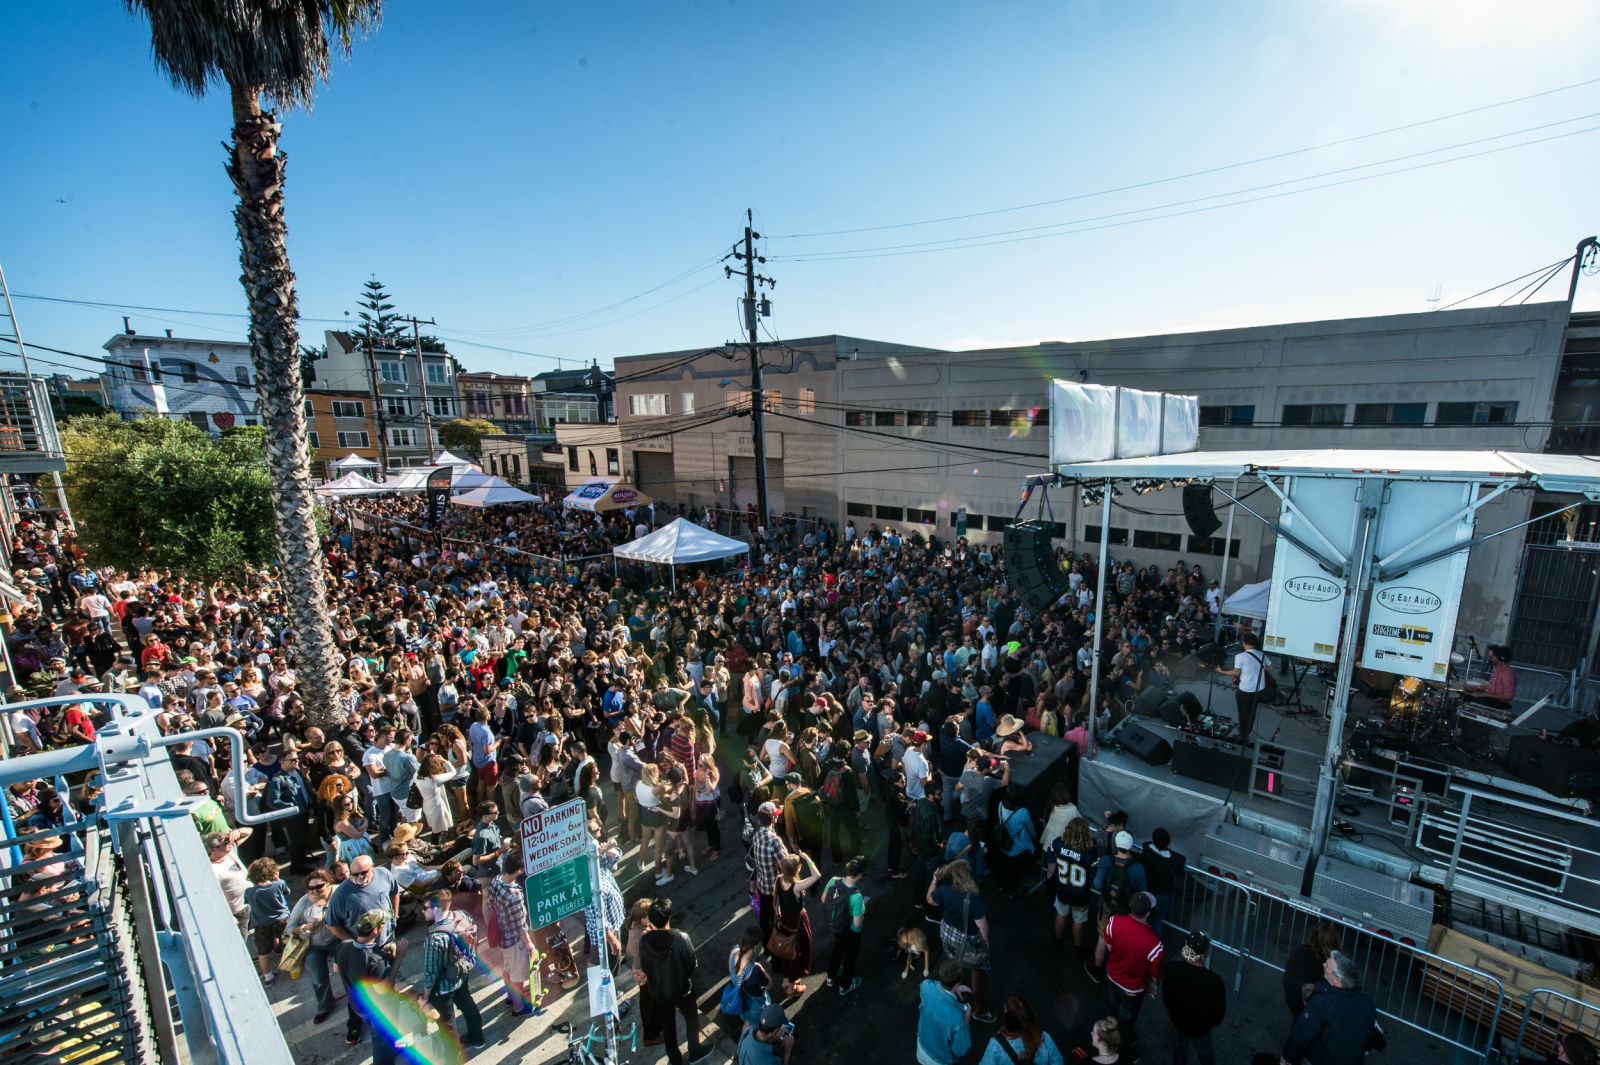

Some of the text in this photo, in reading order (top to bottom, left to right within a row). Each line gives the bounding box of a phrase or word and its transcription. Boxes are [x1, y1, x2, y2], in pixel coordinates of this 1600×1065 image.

[1289, 581, 1301, 590] Big
[1317, 585, 1338, 594] Audio
[1382, 592, 1395, 602] Big
[1397, 594, 1411, 602] Ear
[1414, 595, 1439, 606] Audio
[1374, 624, 1401, 638] STAGELINE
[523, 803, 581, 837] NO PARKING
[529, 832, 582, 862] WEDNESDAY
[1060, 847, 1081, 861] MEANS
[532, 857, 553, 872] STREET
[1056, 857, 1087, 888] 20
[537, 884, 583, 912] PARK AT
[538, 897, 585, 926] 90 DEGREES
